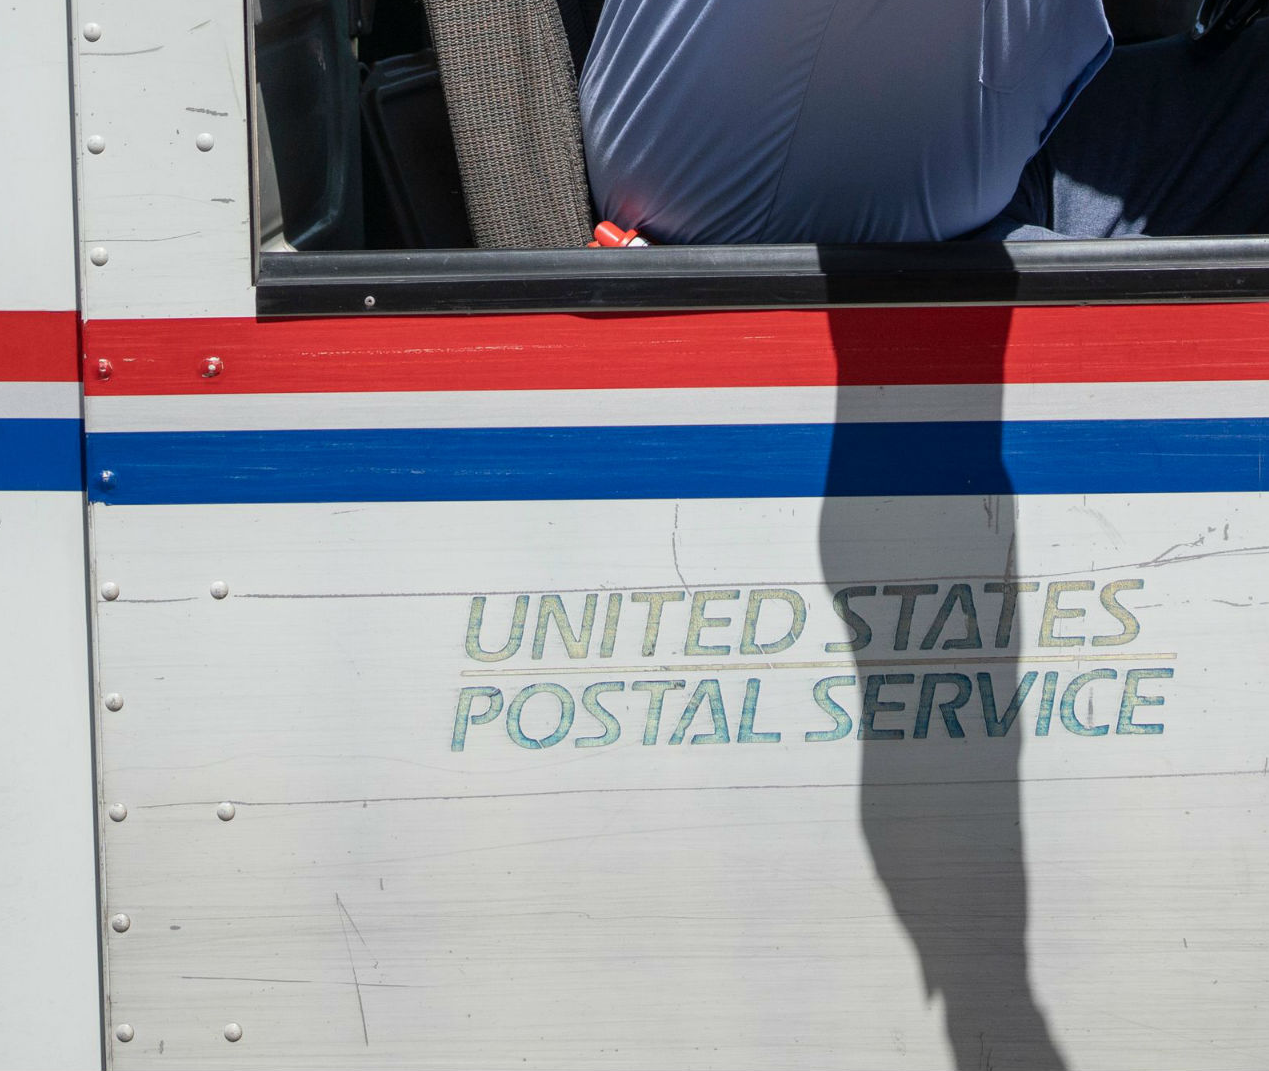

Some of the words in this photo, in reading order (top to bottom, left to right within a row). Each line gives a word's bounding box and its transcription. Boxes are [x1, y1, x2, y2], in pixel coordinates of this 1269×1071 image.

[463, 587, 807, 662] UNITED
[824, 578, 1144, 653] STATES
[450, 678, 782, 752] POSTAL
[804, 667, 1174, 743] SERVICE
